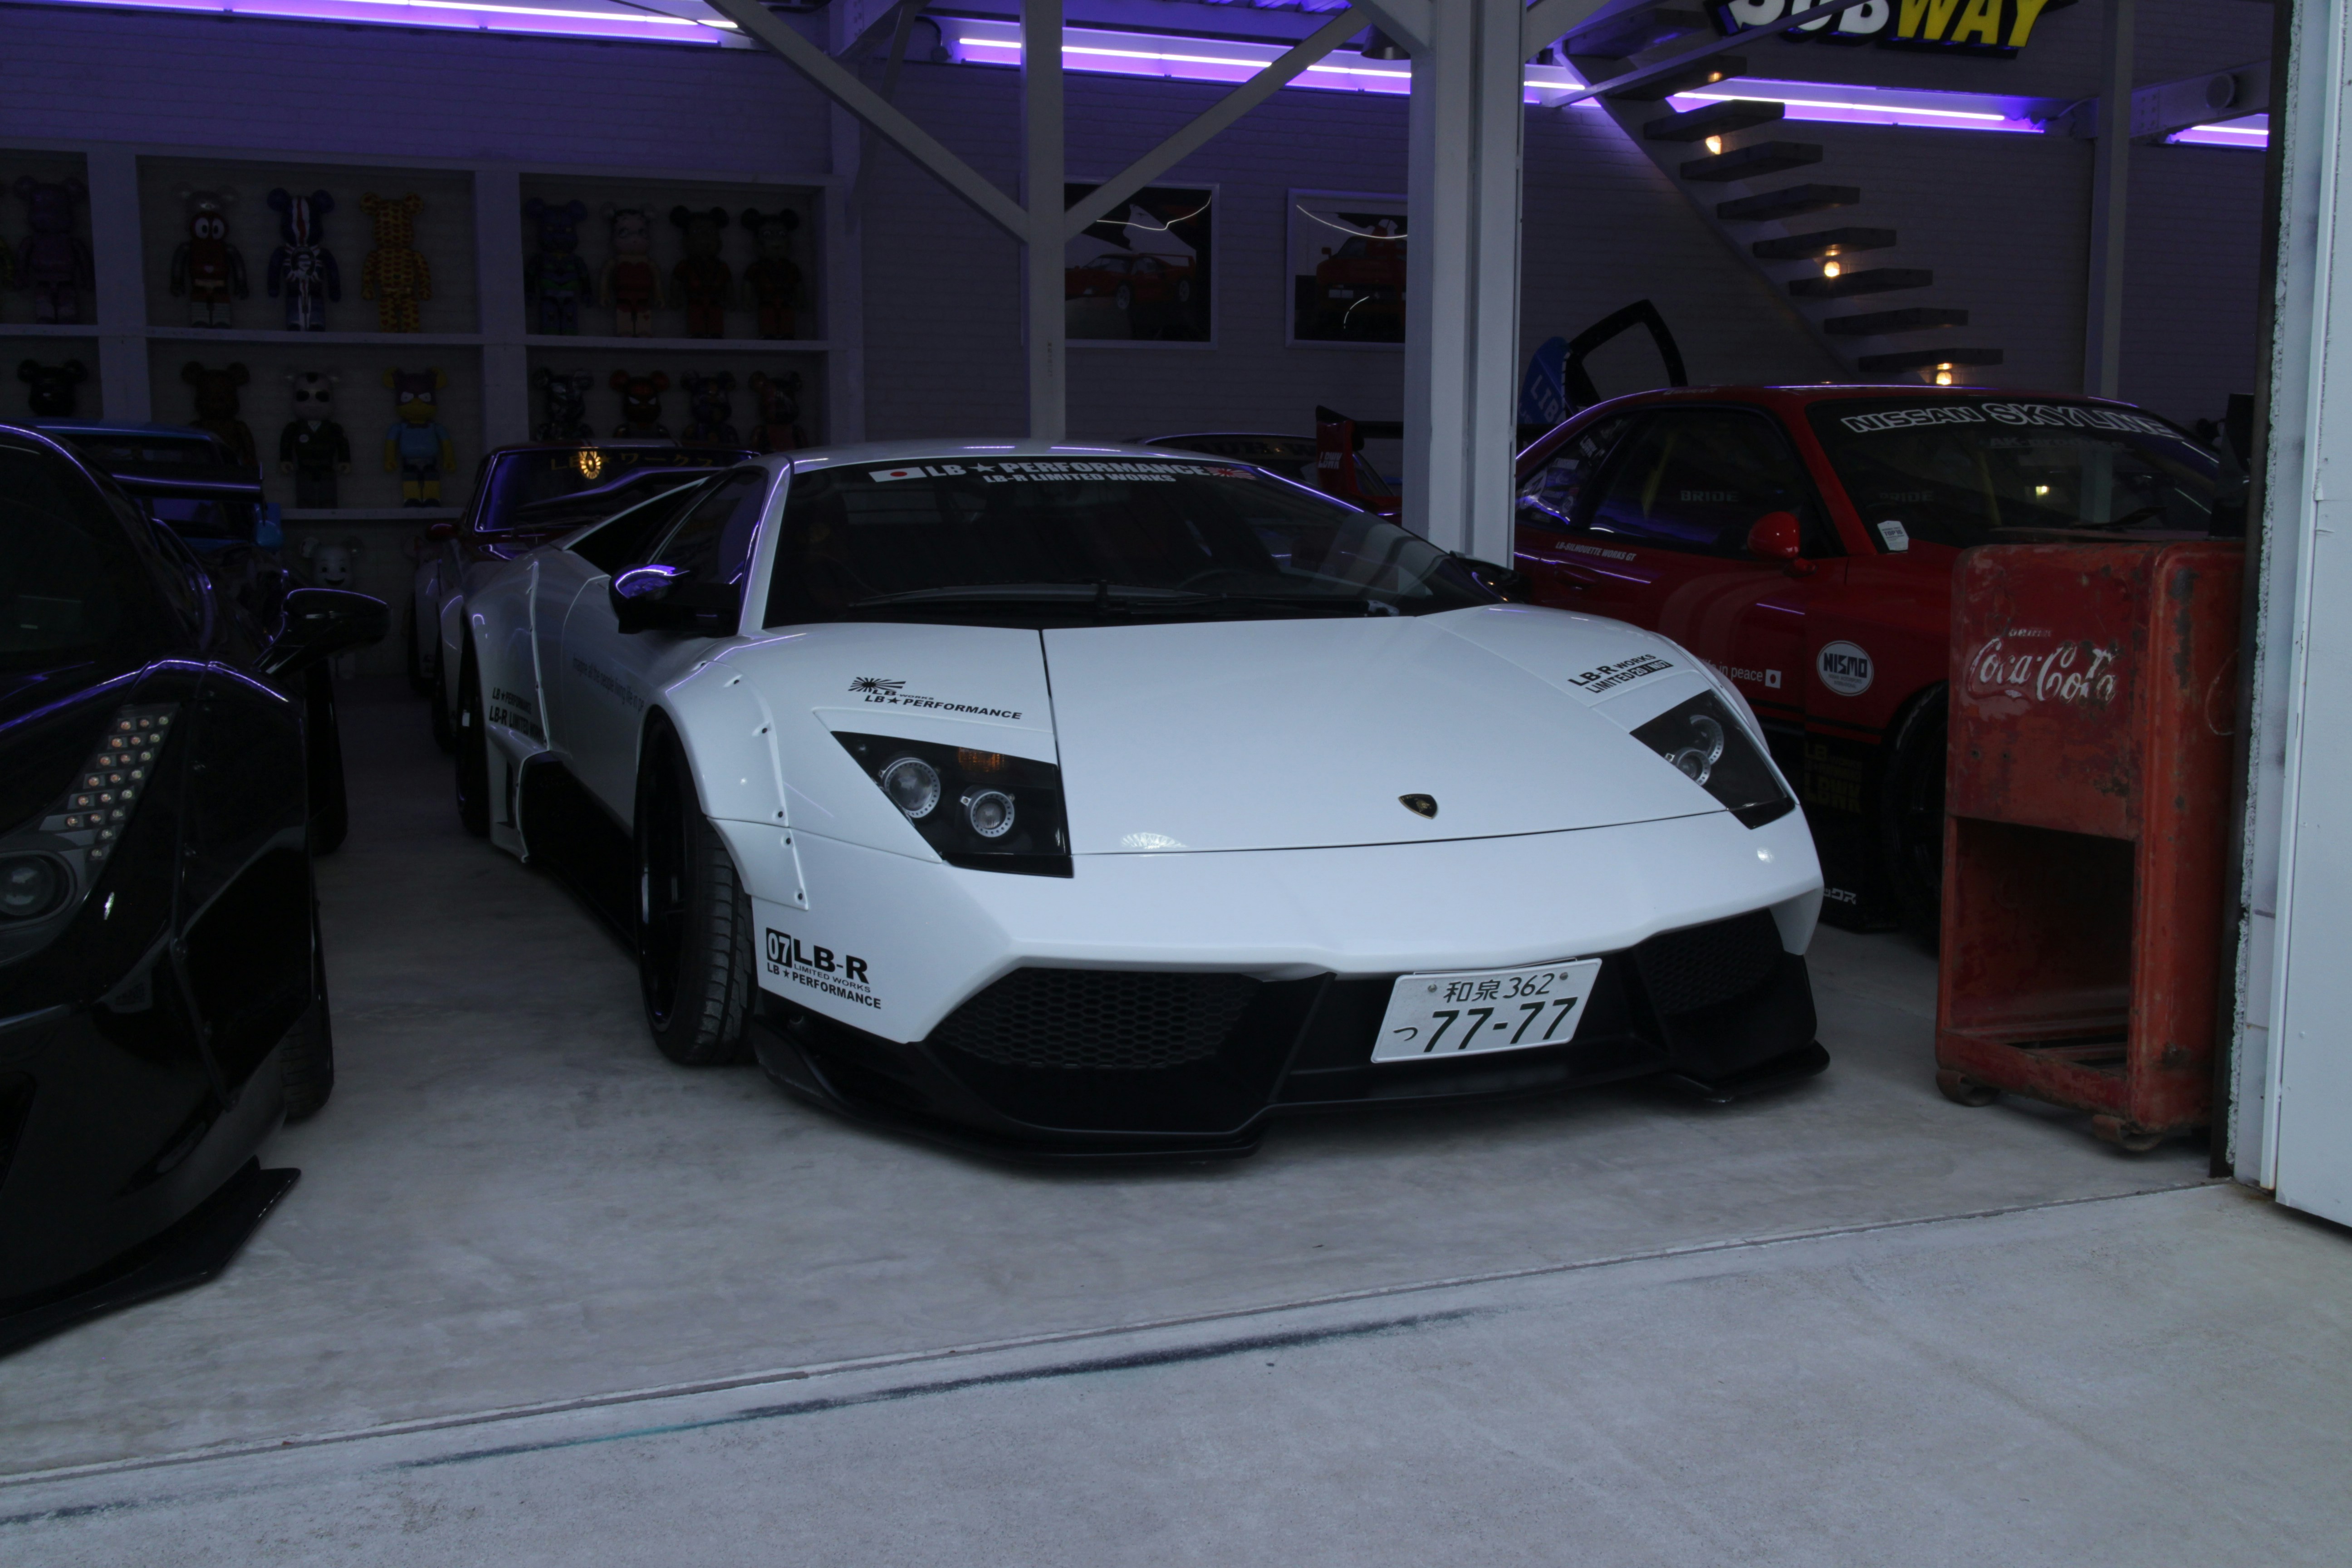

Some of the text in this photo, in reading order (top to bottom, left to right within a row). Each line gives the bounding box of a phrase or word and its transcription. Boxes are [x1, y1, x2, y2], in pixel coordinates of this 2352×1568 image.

[1841, 402, 2185, 440] NISSAN SKYLINE
[621, 454, 714, 466] ワークス
[926, 462, 1205, 476] LB PERFORMANCE
[983, 474, 1028, 483] LB-R
[1105, 473, 1176, 482] WORKS
[1681, 490, 1739, 502] BRIDE
[1555, 541, 1637, 562] LB-SILHOUETTE WORKS GT
[1568, 654, 1656, 686] LB-R WORKS
[1731, 667, 1763, 682] peace
[1824, 652, 1867, 678] NISMO
[1585, 671, 1635, 693] LIMITED
[492, 687, 500, 700] LB
[489, 706, 507, 725] LB-R
[509, 711, 529, 735] LIMITED
[903, 699, 1022, 720] PERFORMANCE
[768, 931, 869, 984] 07 LB-R
[767, 962, 881, 1009] LB PERFORMANCE
[794, 964, 871, 993] LIMITED WORKS
[1393, 997, 1578, 1053] つ 77-77
